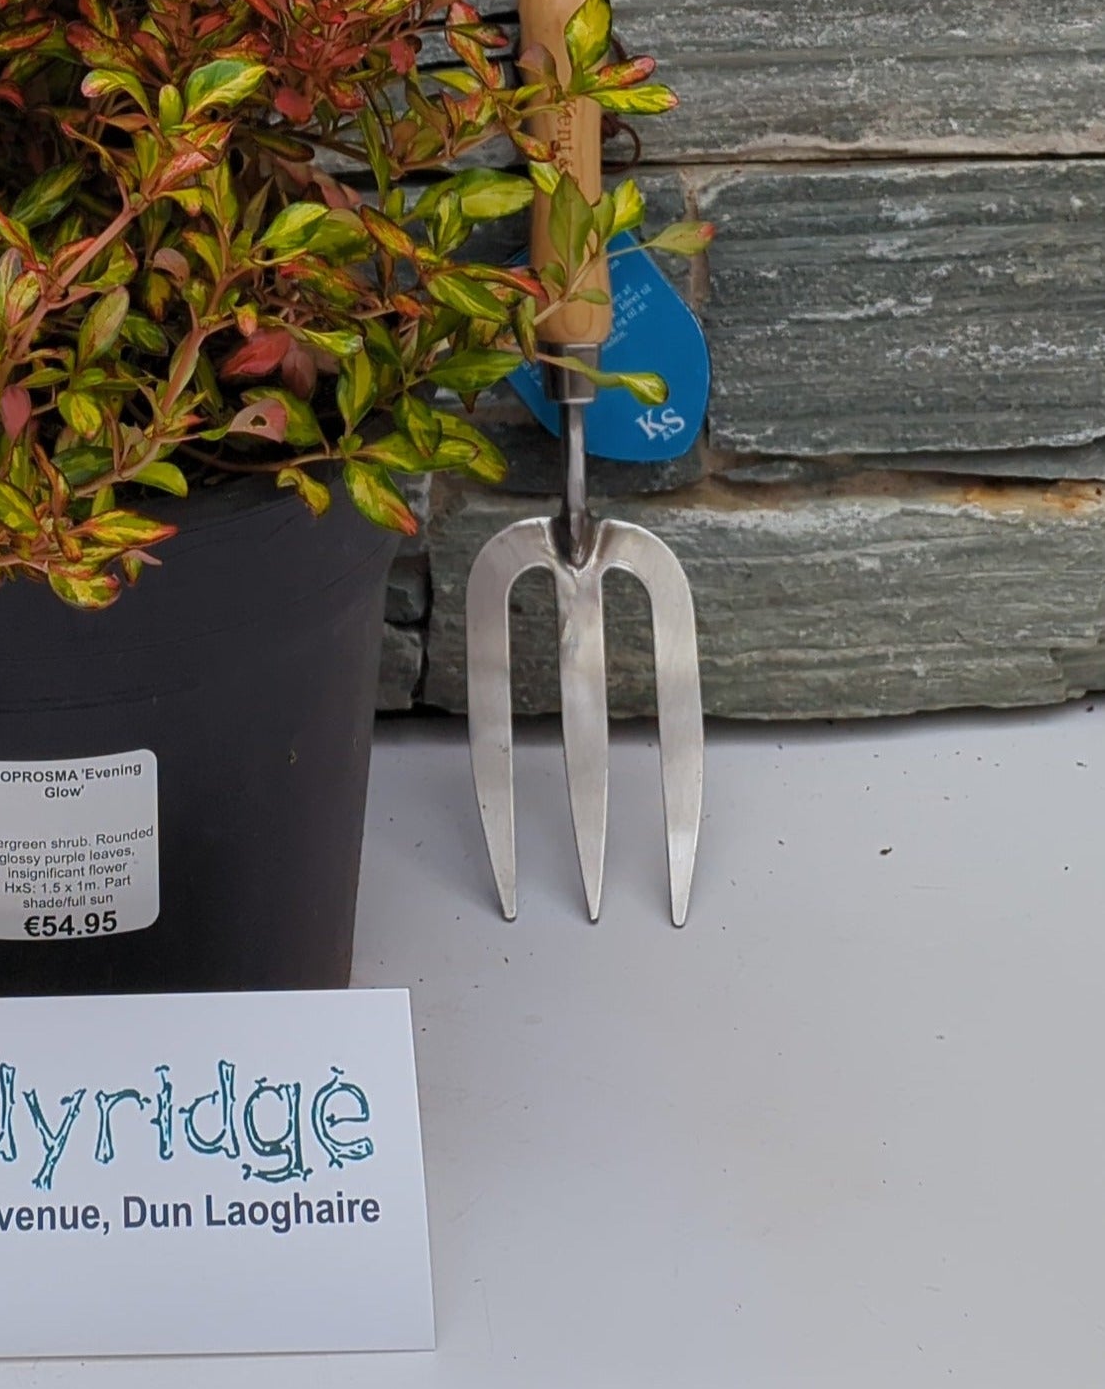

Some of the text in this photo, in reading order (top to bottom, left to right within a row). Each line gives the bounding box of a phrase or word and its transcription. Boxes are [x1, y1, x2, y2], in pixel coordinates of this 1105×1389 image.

[81, 763, 142, 780] 'Evening
[44, 784, 85, 799] Glow'
[51, 835, 92, 849] shrub.
[96, 825, 154, 846] Rounded
[44, 851, 86, 867] purple
[89, 845, 136, 862] leaves,
[7, 860, 127, 882] insignificant flower
[4, 874, 132, 894] HxS: 1.5 x 1m. Part
[22, 892, 114, 910] shade/full sun
[23, 909, 118, 938] €54.95
[122, 1195, 193, 1229] Dun
[204, 1190, 381, 1234] Laoghaire
